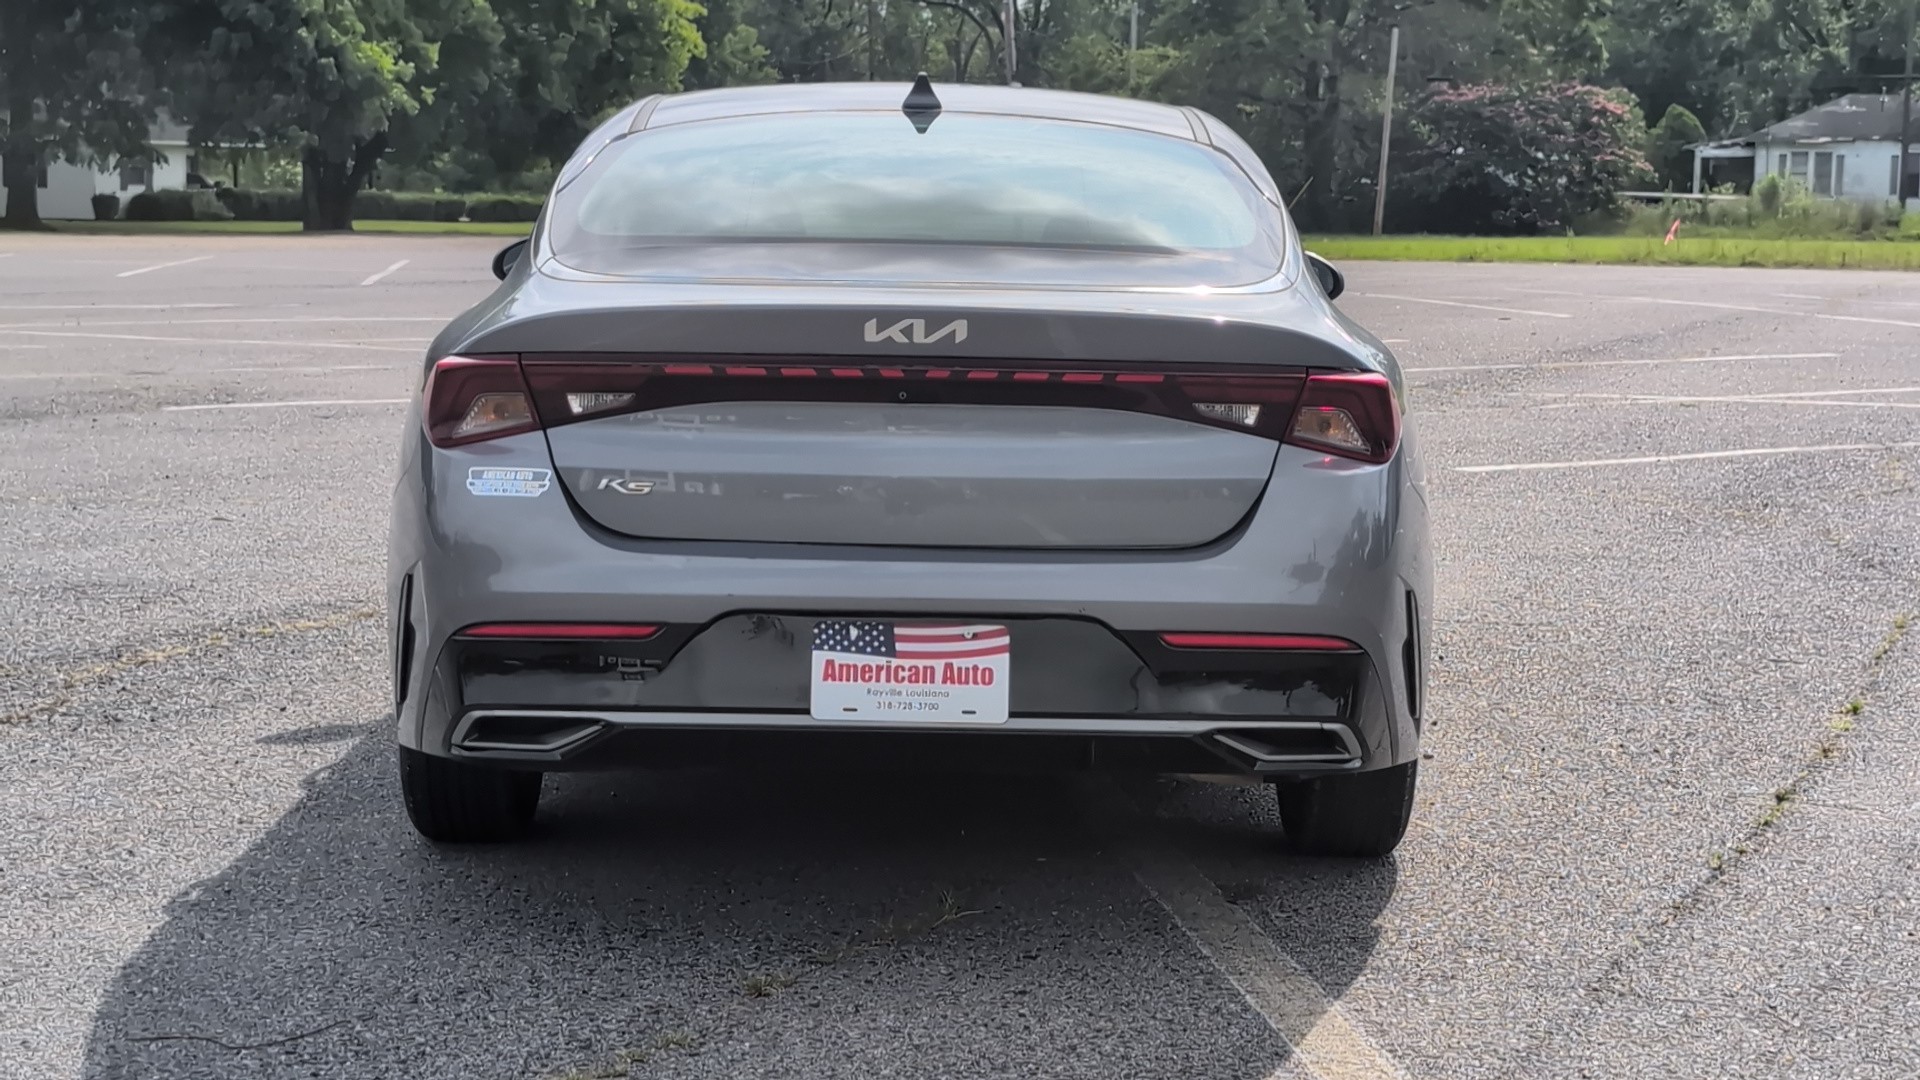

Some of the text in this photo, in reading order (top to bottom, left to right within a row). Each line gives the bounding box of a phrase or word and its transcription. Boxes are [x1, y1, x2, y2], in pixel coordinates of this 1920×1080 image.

[864, 318, 968, 344] KIA
[822, 659, 994, 686] American Auto
[866, 688, 949, 698] Rayville Louisiana
[876, 701, 939, 711] 318-728-3700
